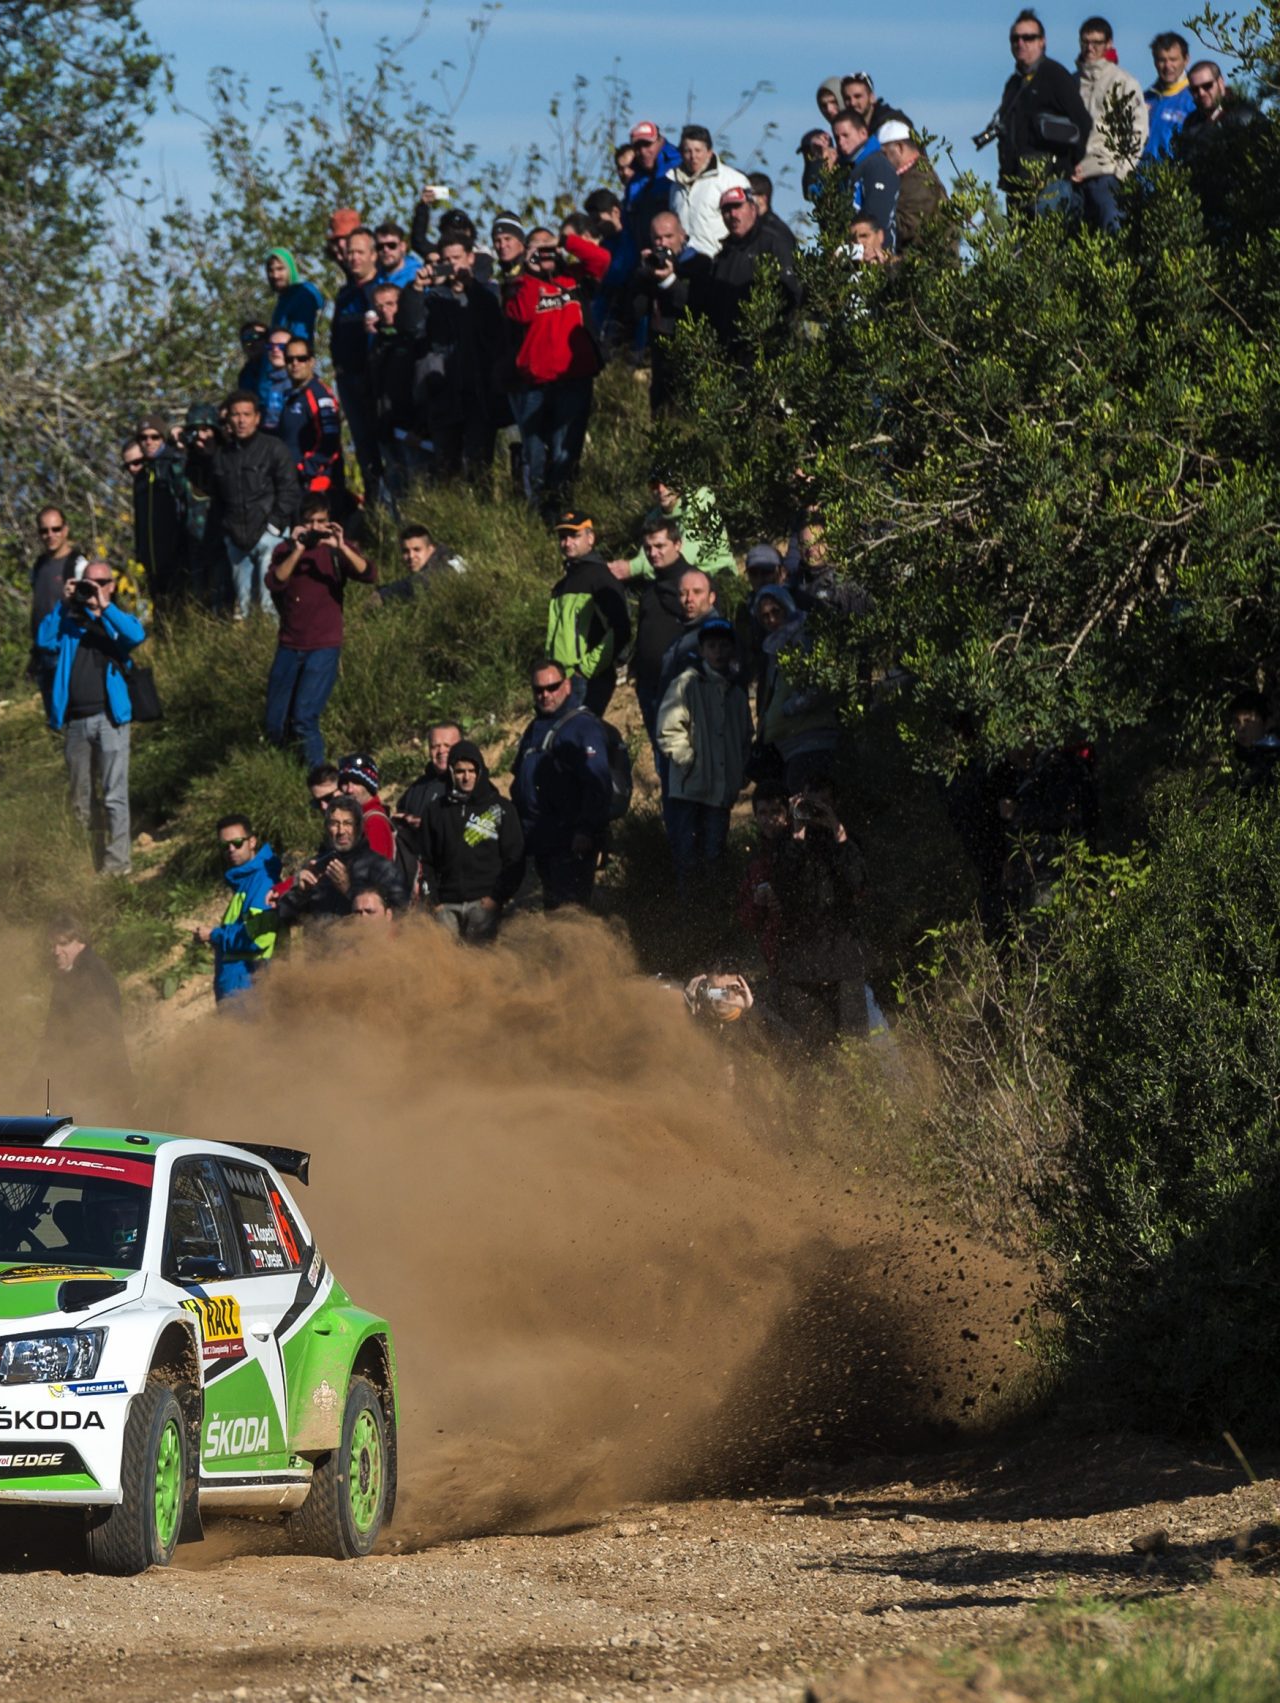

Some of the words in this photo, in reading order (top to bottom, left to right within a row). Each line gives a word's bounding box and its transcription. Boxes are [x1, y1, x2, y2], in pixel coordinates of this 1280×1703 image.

[206, 1298, 239, 1337] RACC
[76, 1383, 125, 1393] MICHELIN
[204, 1412, 269, 1458] ŠKODA
[12, 1453, 65, 1467] EDGE
